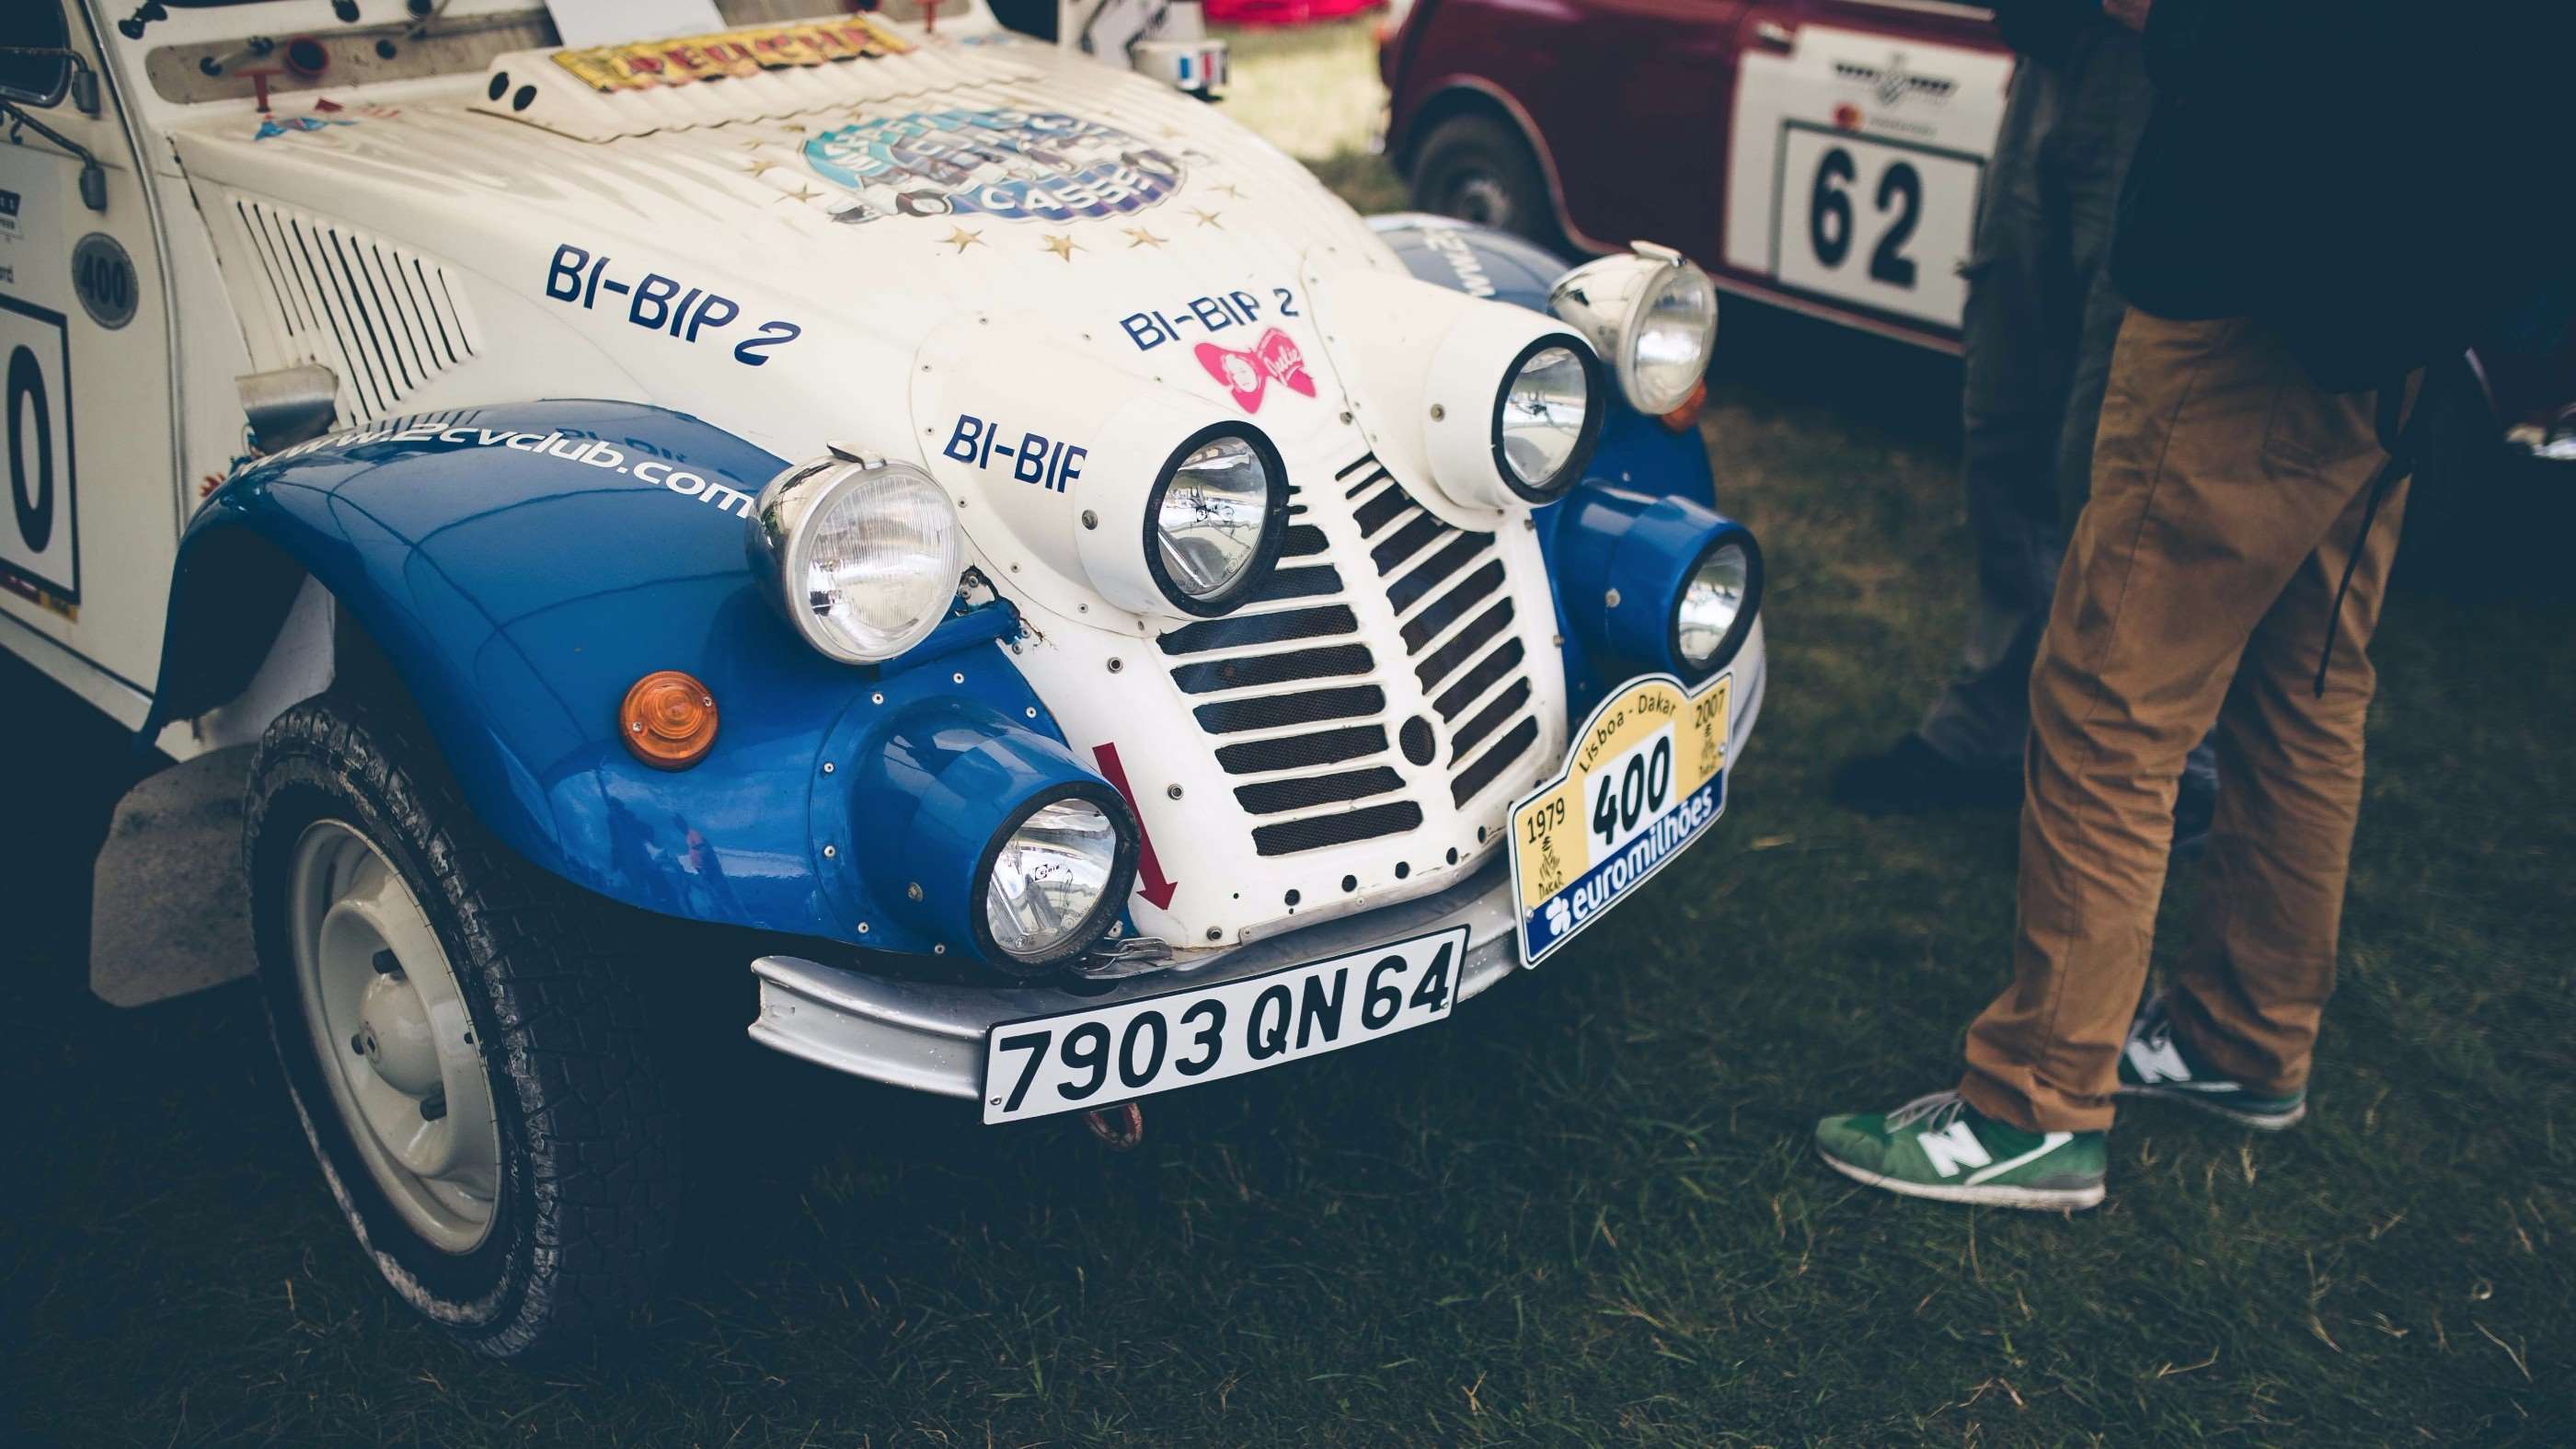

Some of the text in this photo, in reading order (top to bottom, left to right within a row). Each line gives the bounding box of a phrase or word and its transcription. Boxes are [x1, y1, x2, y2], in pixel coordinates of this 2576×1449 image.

[1811, 147, 1922, 289] 62
[80, 252, 128, 308] 400
[546, 243, 801, 366] BI-BIP 2
[1119, 288, 1299, 351] BI-BIP 2
[1579, 711, 1625, 773] Lisboa
[1638, 692, 1677, 720] Dakar
[1695, 688, 1725, 729] 2007
[1527, 797, 1565, 845] 1979
[1593, 736, 1670, 846] 400
[1572, 786, 1712, 921] euromilhões
[999, 942, 1455, 1113] 7903 QN 64
[1918, 1120, 1993, 1178] N
